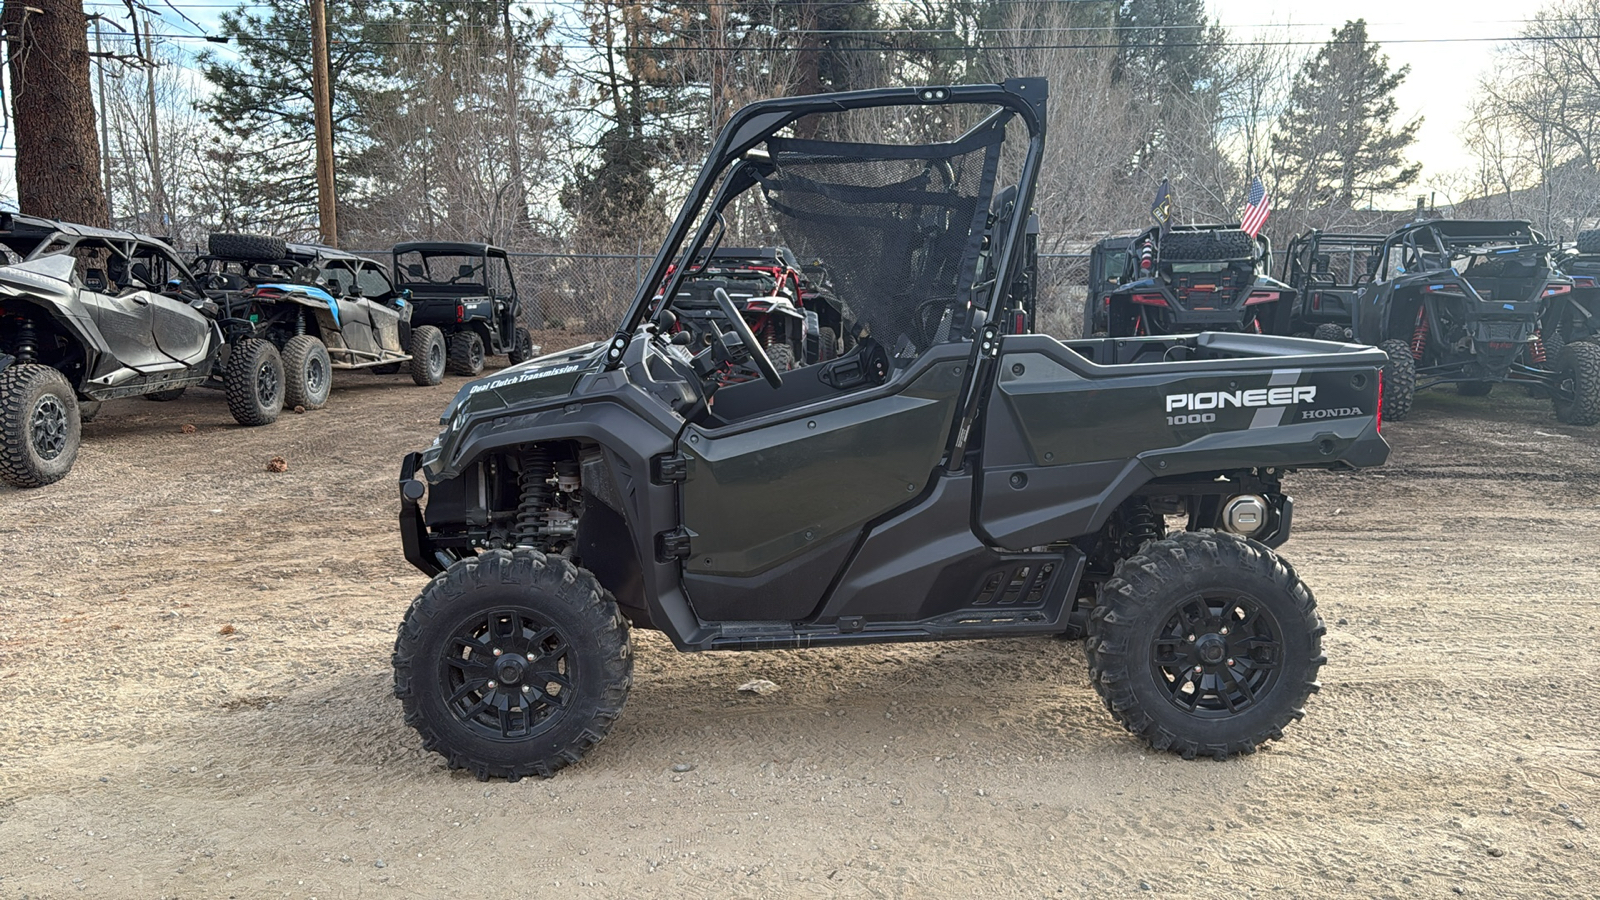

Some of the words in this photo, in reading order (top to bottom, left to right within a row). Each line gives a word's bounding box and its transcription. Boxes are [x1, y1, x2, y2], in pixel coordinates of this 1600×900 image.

[469, 382, 489, 394] Dual
[490, 376, 519, 389] Clutch
[519, 365, 579, 382] Transmission
[1166, 386, 1316, 412] PIONEER
[1166, 413, 1216, 425] 1000
[1302, 407, 1363, 418] HONDA
